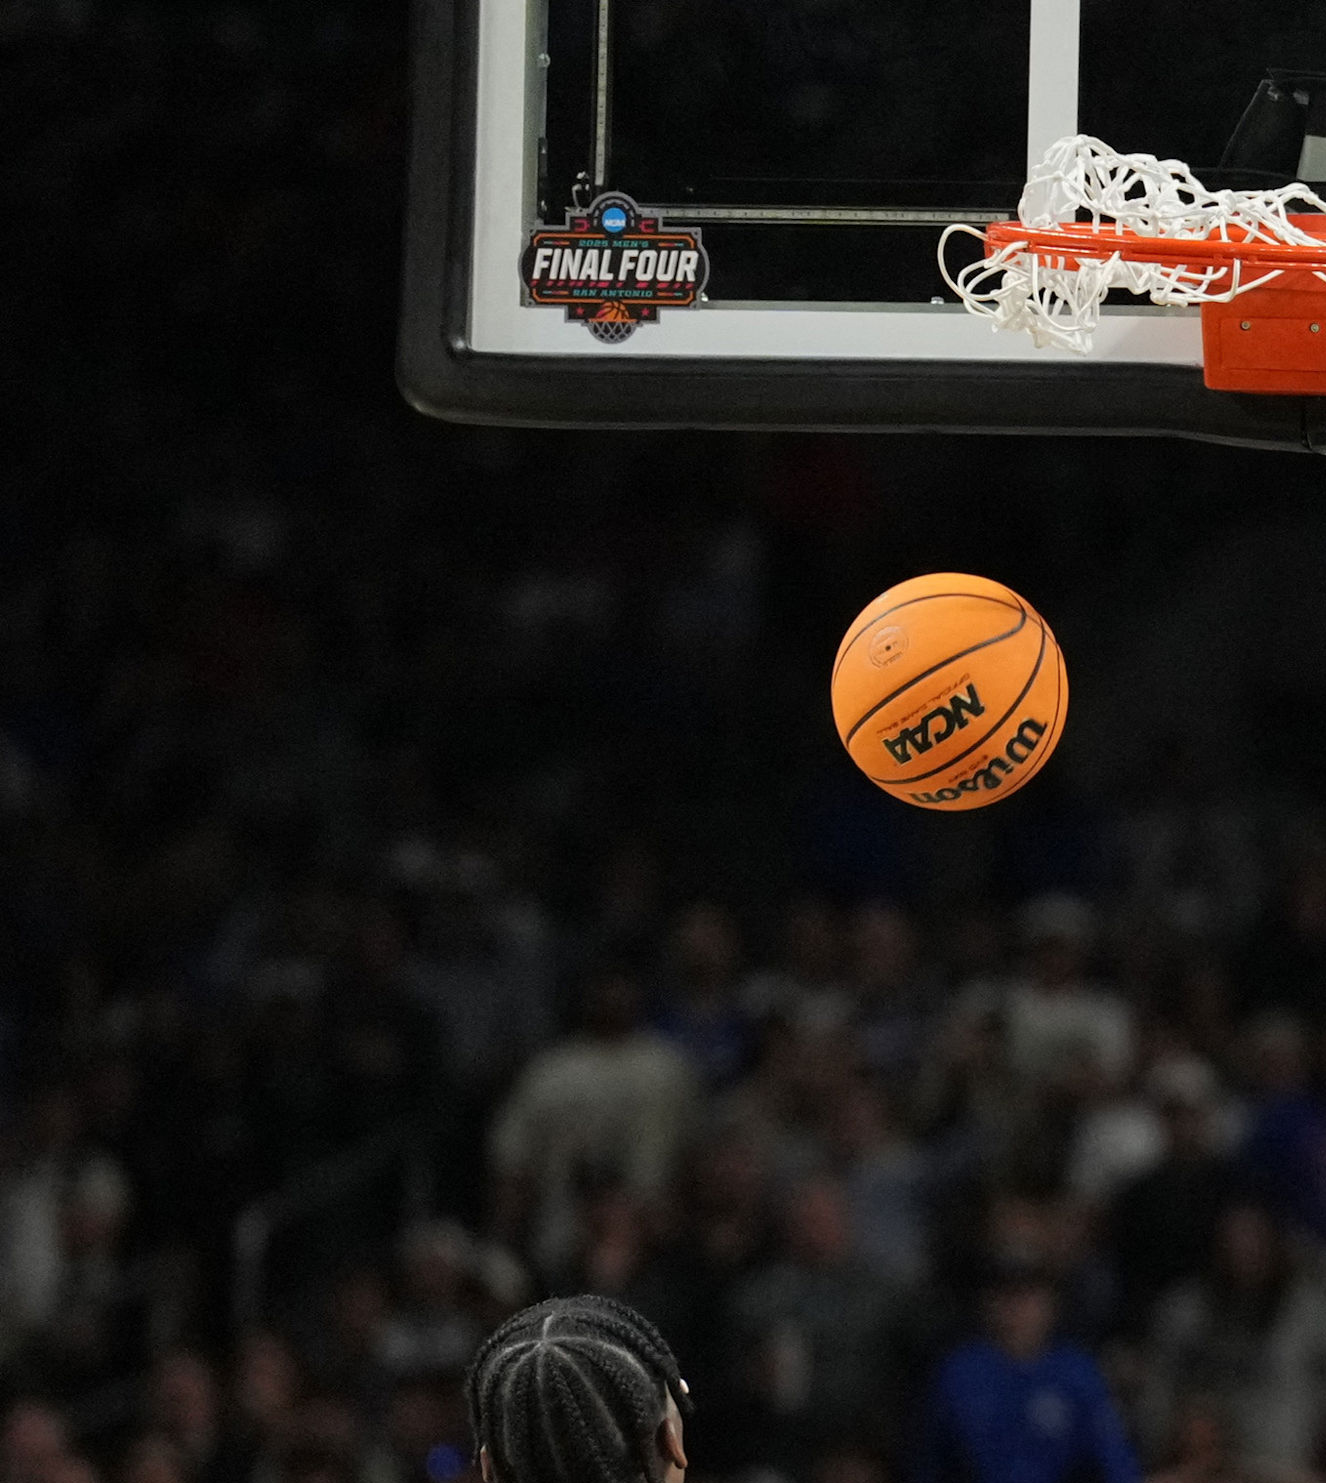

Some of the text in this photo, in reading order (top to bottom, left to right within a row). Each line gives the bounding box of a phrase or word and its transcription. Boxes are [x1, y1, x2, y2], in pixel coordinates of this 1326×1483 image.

[532, 248, 699, 282] FINAL FOUR
[600, 289, 653, 298] ANTONIO
[882, 683, 985, 765] NCAA
[909, 716, 1048, 804] Wilson
